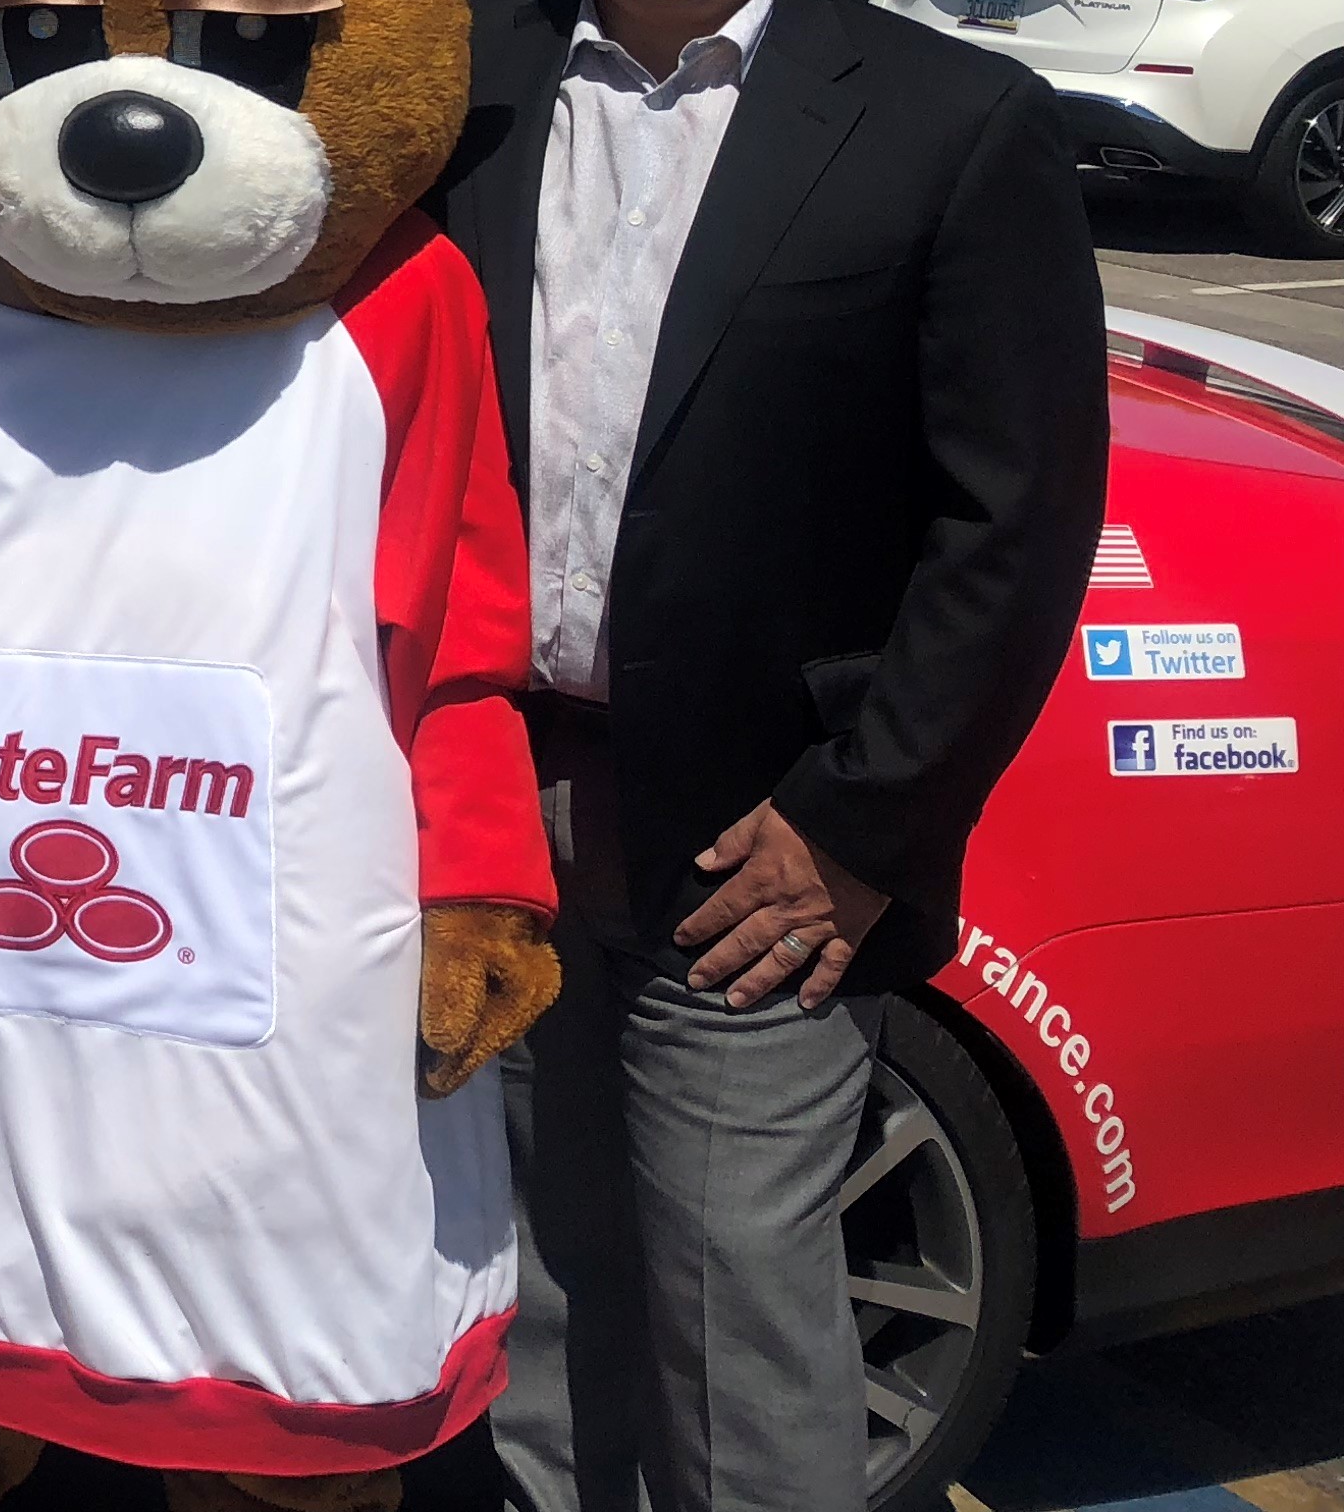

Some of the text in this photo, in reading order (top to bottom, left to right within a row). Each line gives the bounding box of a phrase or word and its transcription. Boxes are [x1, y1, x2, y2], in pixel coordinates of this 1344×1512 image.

[1073, 0, 1131, 11] PLATINUM
[1142, 629, 1236, 645] Follow us on
[1145, 649, 1236, 675] Twitter
[1172, 724, 1258, 740] Find us on:
[1174, 742, 1287, 771] facebook
[958, 916, 1136, 1215] rance.com
